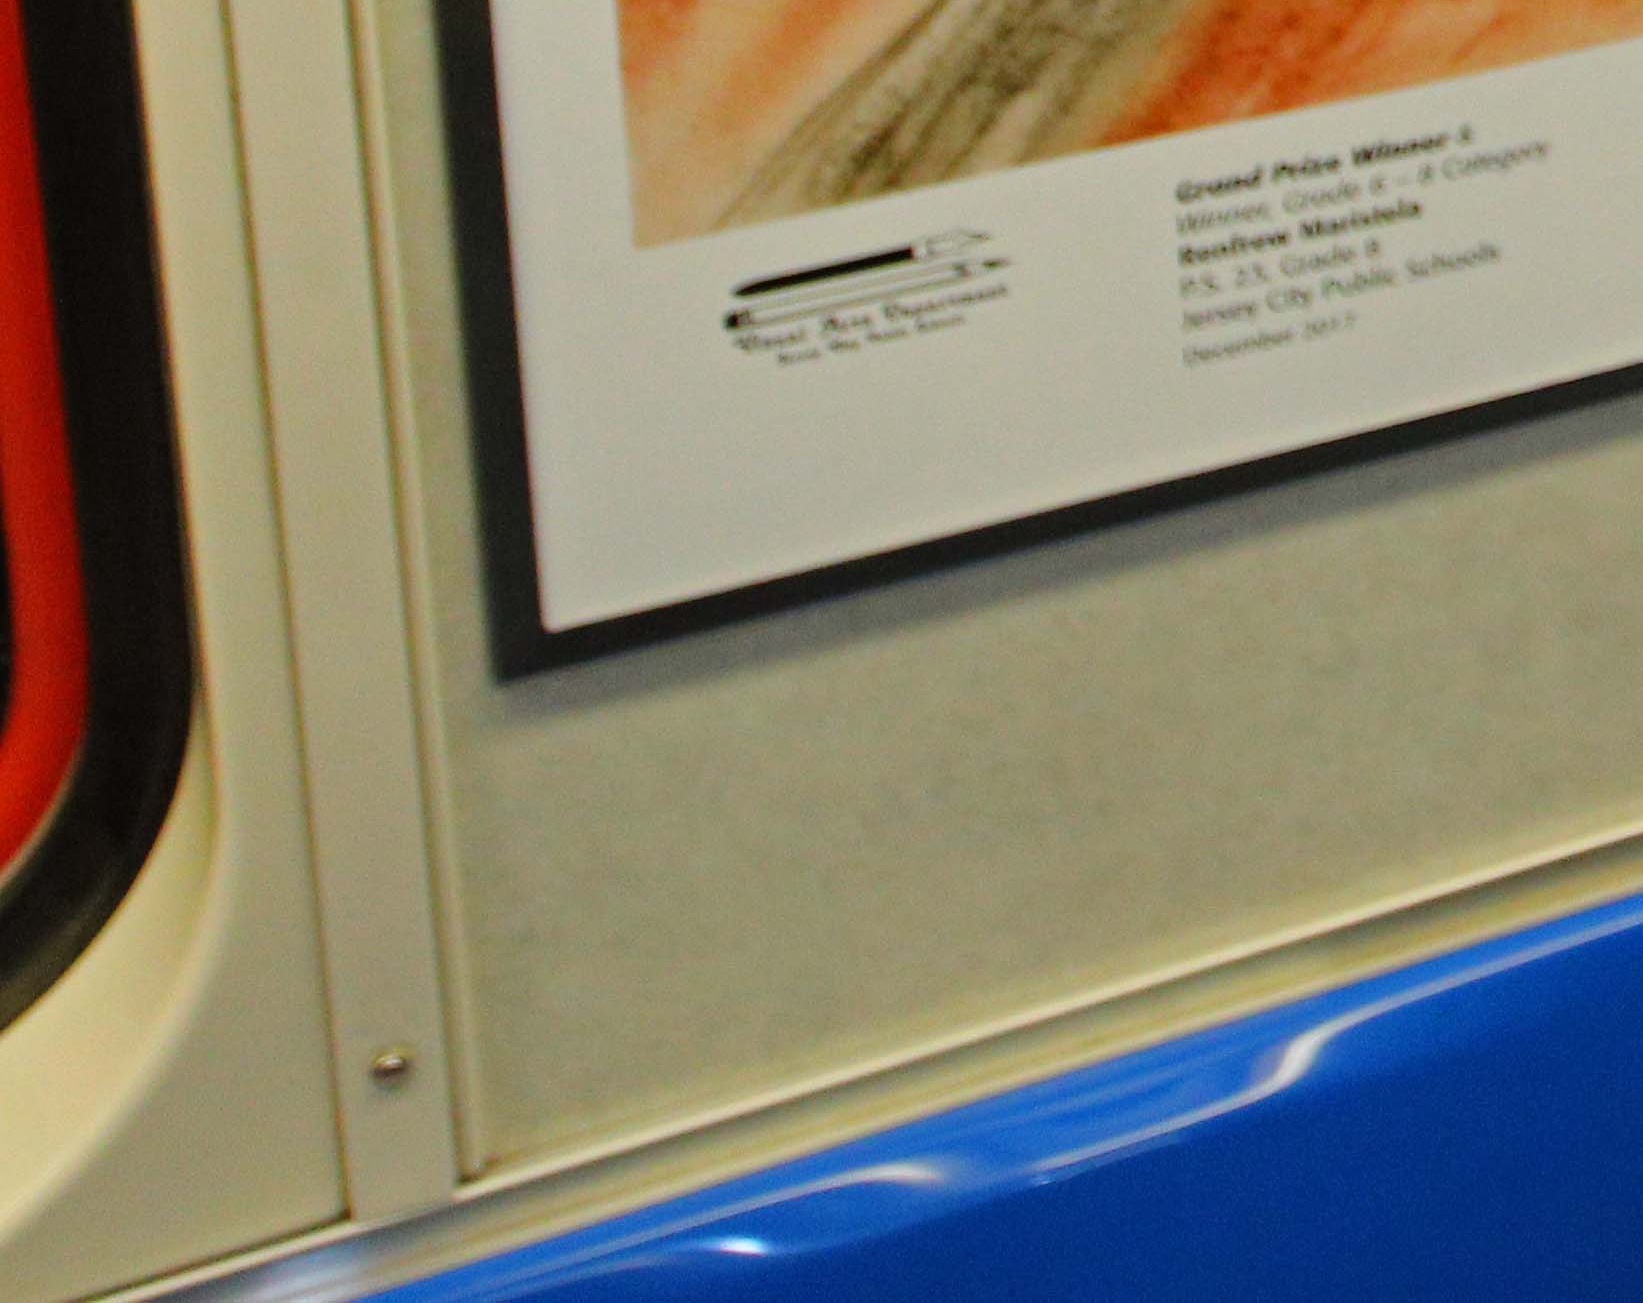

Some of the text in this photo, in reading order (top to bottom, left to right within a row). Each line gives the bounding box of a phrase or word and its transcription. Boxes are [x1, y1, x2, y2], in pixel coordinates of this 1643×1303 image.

[1174, 161, 1264, 205] Grand
[1270, 153, 1343, 184] Prize
[1350, 128, 1451, 168] Winner
[1440, 138, 1552, 182] Category
[1403, 239, 1501, 281] Schools
